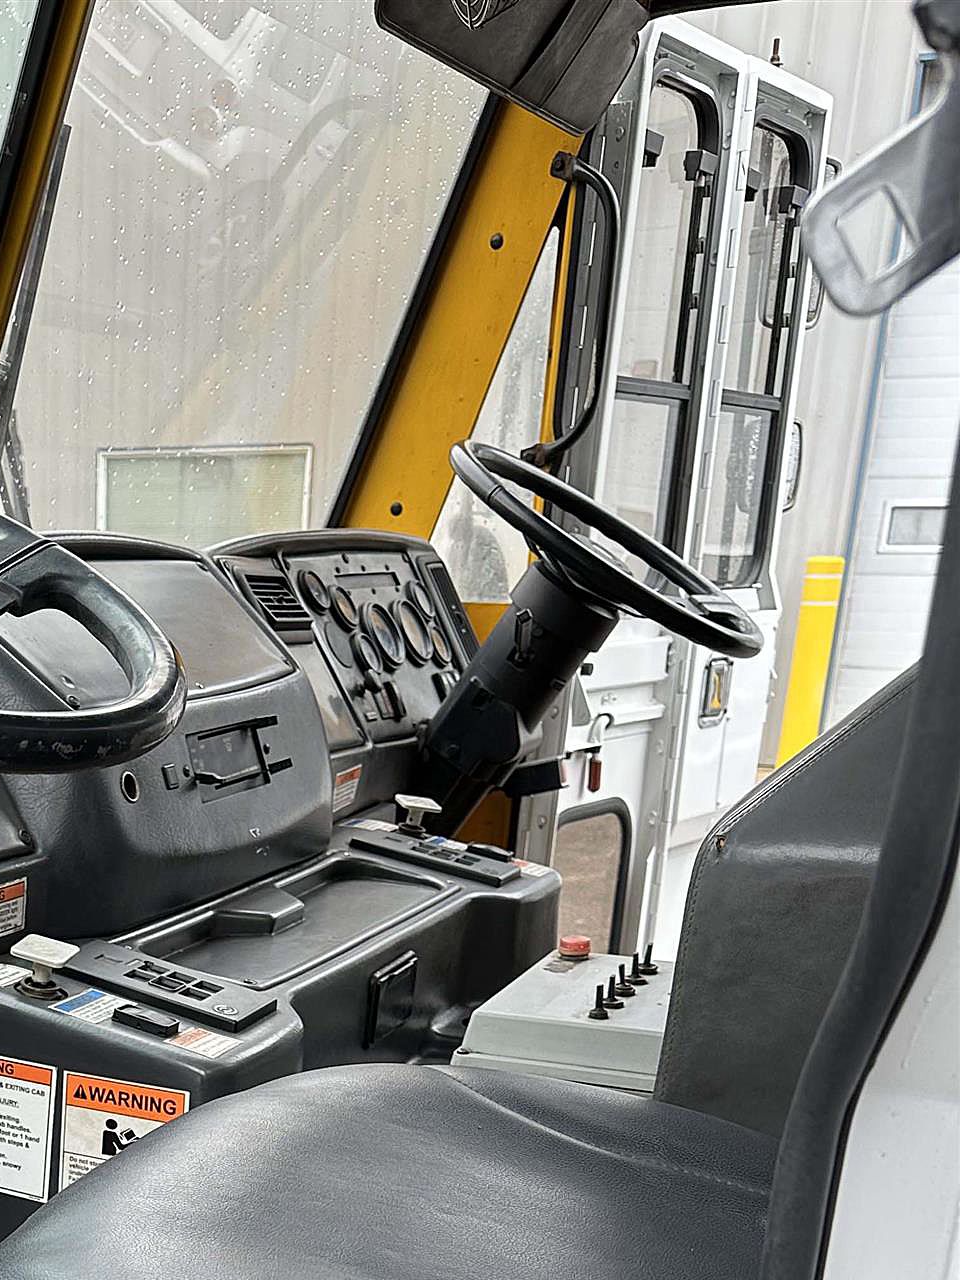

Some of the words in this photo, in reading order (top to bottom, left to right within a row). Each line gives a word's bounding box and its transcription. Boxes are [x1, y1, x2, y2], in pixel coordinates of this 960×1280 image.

[4, 1082, 29, 1092] EXITING
[31, 1087, 45, 1097] CAB
[88, 1085, 177, 1115] WARNING
[24, 1134, 39, 1143] hand
